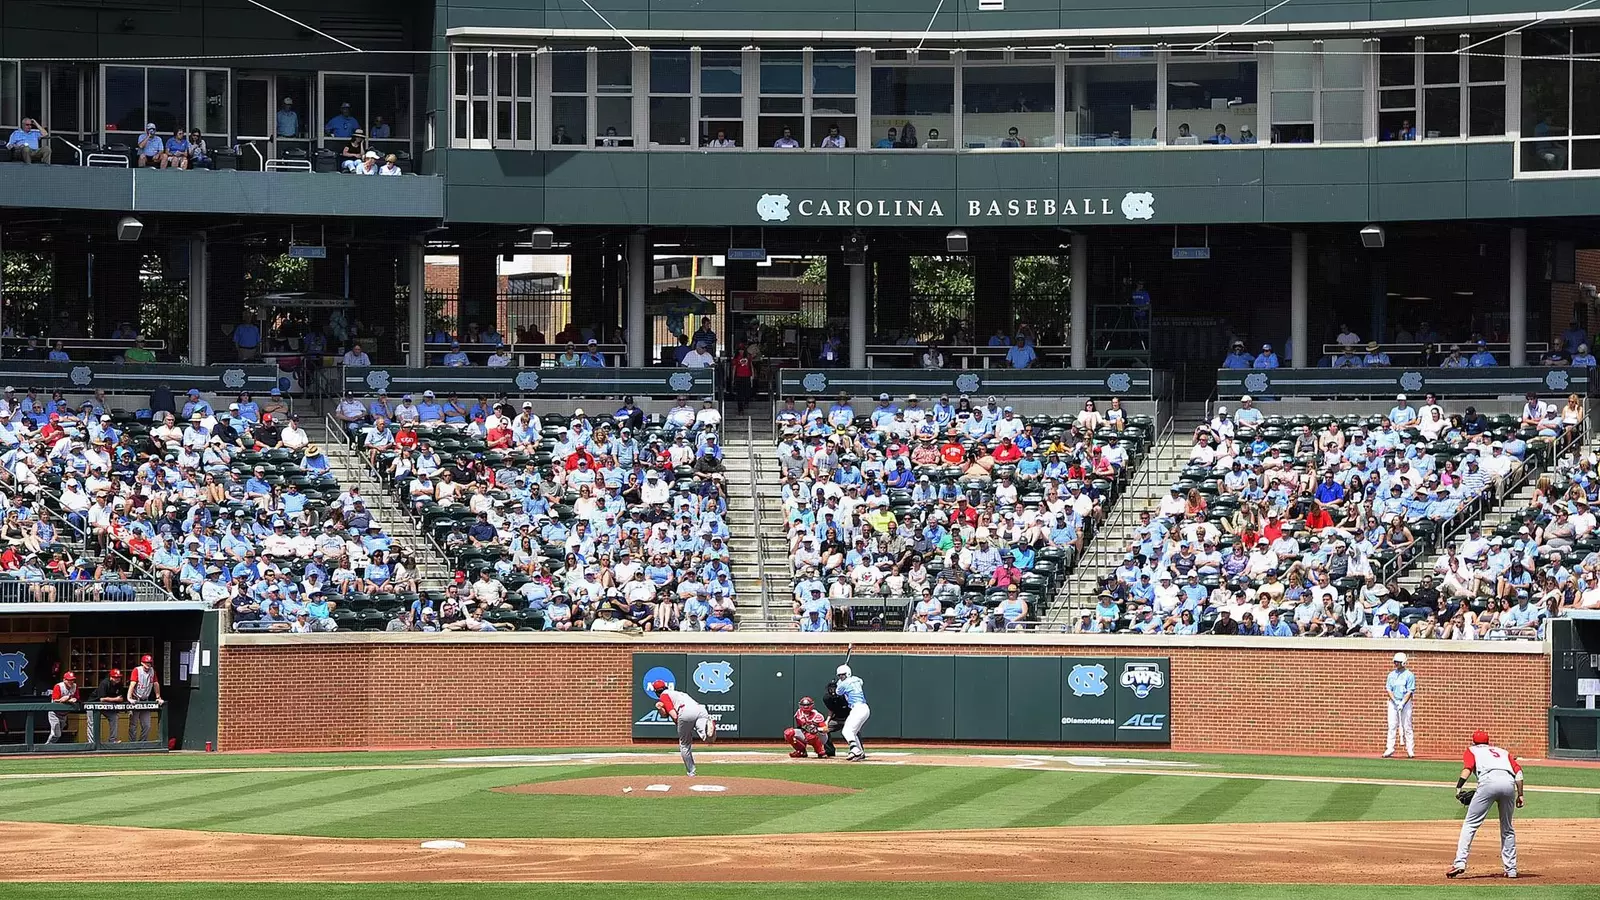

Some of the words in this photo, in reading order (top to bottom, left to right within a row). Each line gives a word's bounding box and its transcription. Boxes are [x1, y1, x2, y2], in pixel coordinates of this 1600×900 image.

[798, 199, 944, 217] CAROLINA
[967, 198, 1113, 216] BASEBALL
[1121, 671, 1163, 685] CWS
[707, 704, 735, 712] TICKETS
[1061, 717, 1115, 725] @DiamondHeels
[1122, 714, 1166, 726] ACC
[1489, 748, 1501, 758] 5
